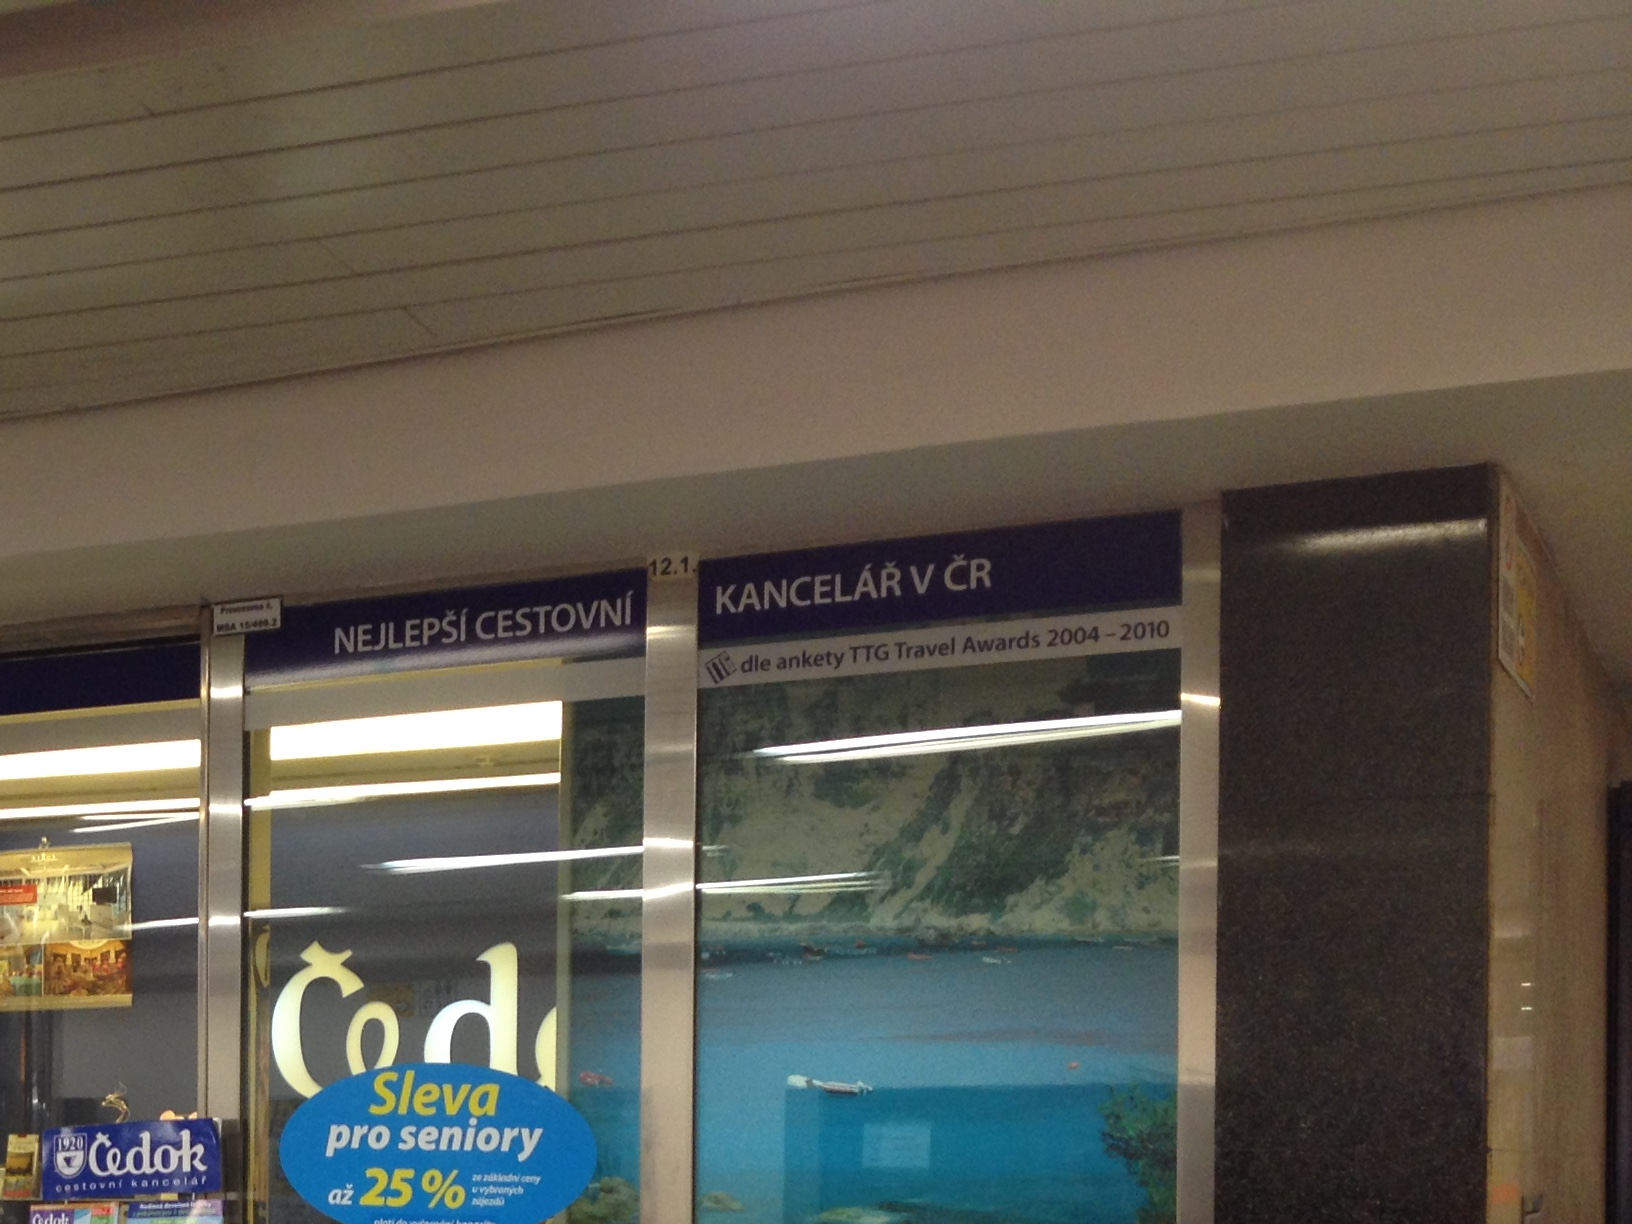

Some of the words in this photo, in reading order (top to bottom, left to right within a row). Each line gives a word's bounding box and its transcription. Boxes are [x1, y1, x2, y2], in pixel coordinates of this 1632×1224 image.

[715, 563, 902, 615] KANCELÁŘ
[909, 563, 936, 595] V
[943, 553, 993, 594] ČR
[333, 607, 468, 655] NEJLEPŠÍ
[475, 590, 635, 641] CESTOVNÍ
[739, 649, 770, 674] dle
[776, 646, 845, 673] ankety
[849, 643, 889, 664] TTG
[894, 636, 956, 660] Travel
[962, 631, 1041, 654] Awards
[1046, 626, 1099, 648] 2004
[1120, 619, 1170, 642] 2010
[271, 940, 557, 1099] Čed
[369, 1070, 500, 1116] Sleva
[58, 1136, 84, 1151] 1920
[88, 1129, 208, 1176] Čedok
[325, 1124, 391, 1158] pro
[398, 1117, 543, 1162] seniory
[56, 1179, 123, 1193] cestovní
[131, 1175, 208, 1189] kancelář
[327, 1183, 354, 1205] až
[360, 1167, 415, 1208] 25
[421, 1169, 466, 1210] %
[480, 1186, 524, 1196] vybraných
[483, 1173, 520, 1183] základní
